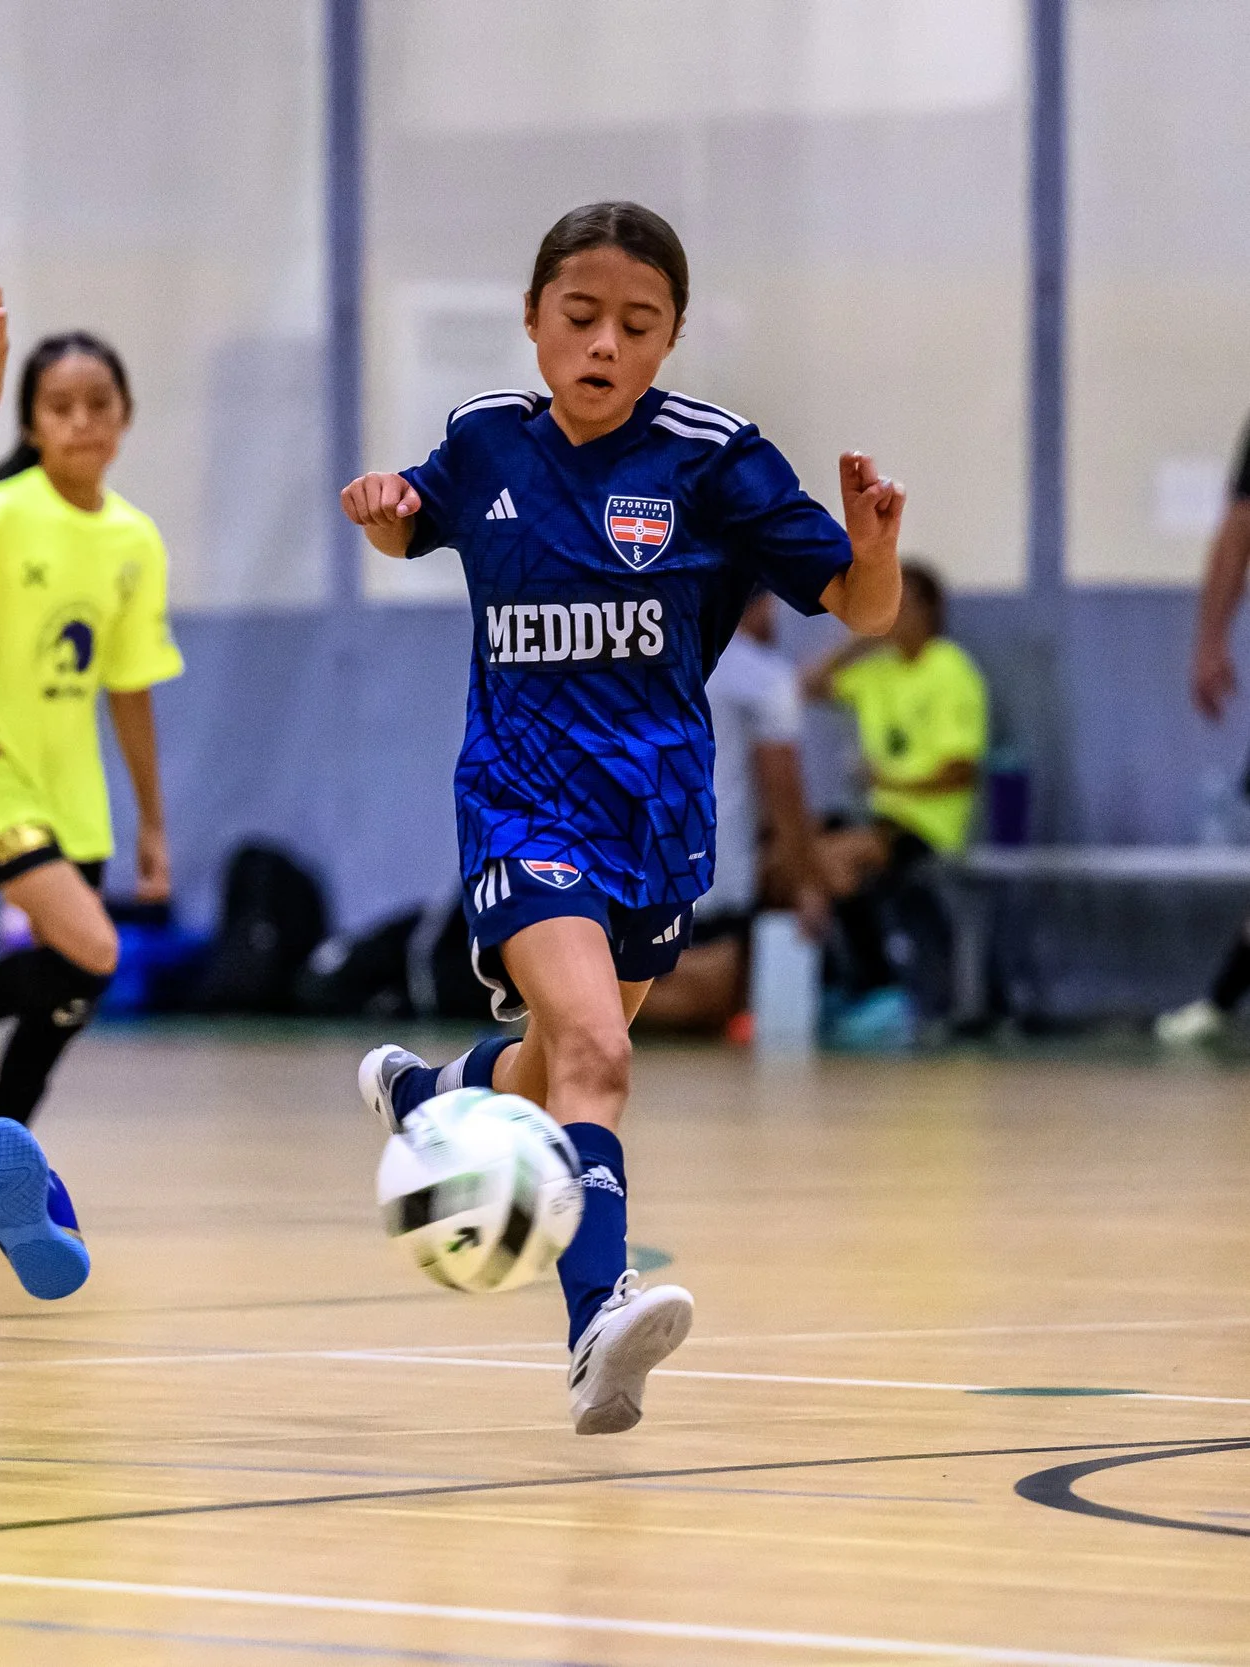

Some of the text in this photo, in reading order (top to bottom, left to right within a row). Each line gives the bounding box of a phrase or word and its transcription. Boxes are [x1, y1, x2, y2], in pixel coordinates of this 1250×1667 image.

[613, 501, 667, 511] SPORTING
[617, 509, 662, 517] WICHITA
[486, 599, 664, 663] MEDDYS
[581, 1176, 624, 1197] didas
